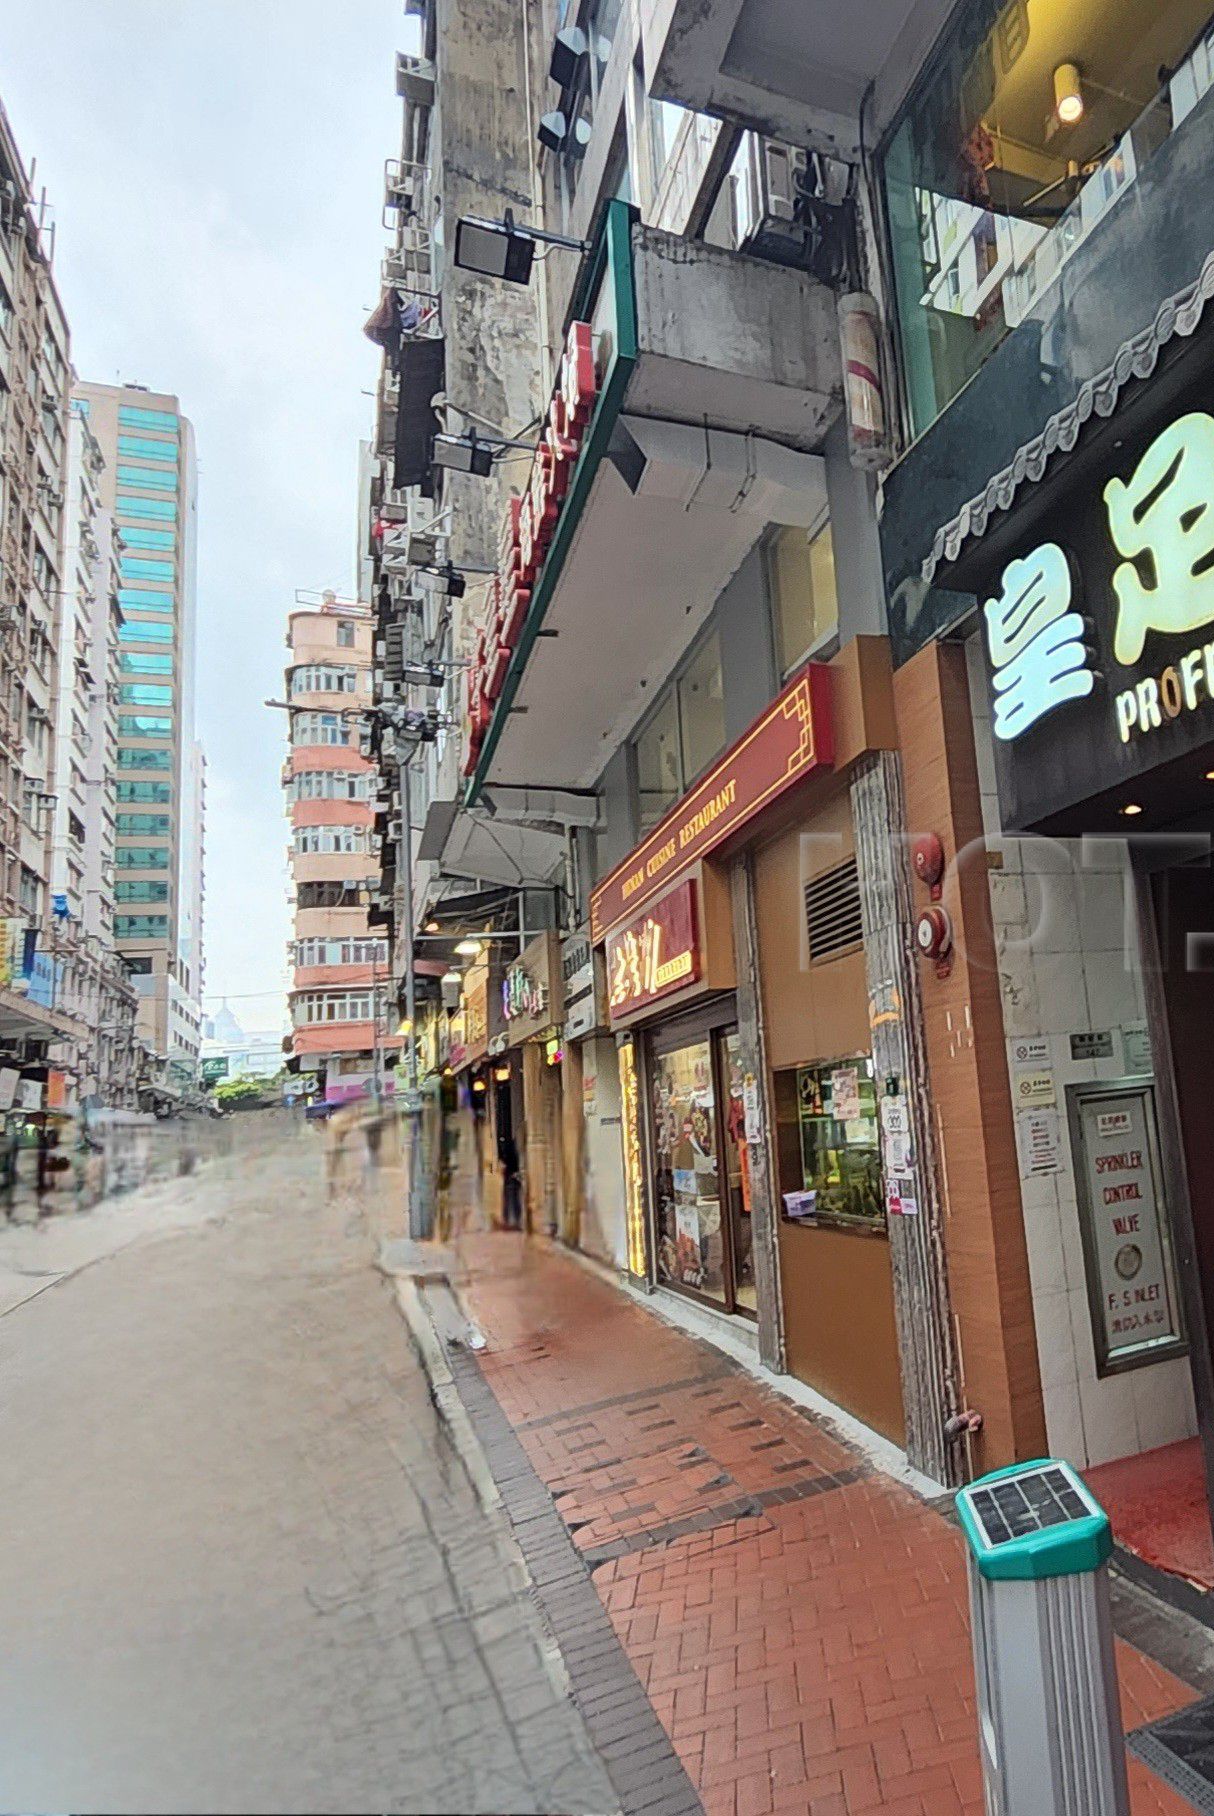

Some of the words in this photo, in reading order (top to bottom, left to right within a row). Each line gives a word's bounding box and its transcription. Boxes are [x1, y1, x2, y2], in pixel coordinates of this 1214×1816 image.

[679, 779, 736, 850] RESTAURANT
[1095, 1151, 1143, 1174] SPRINKLER
[1103, 1183, 1143, 1205] CONTROL
